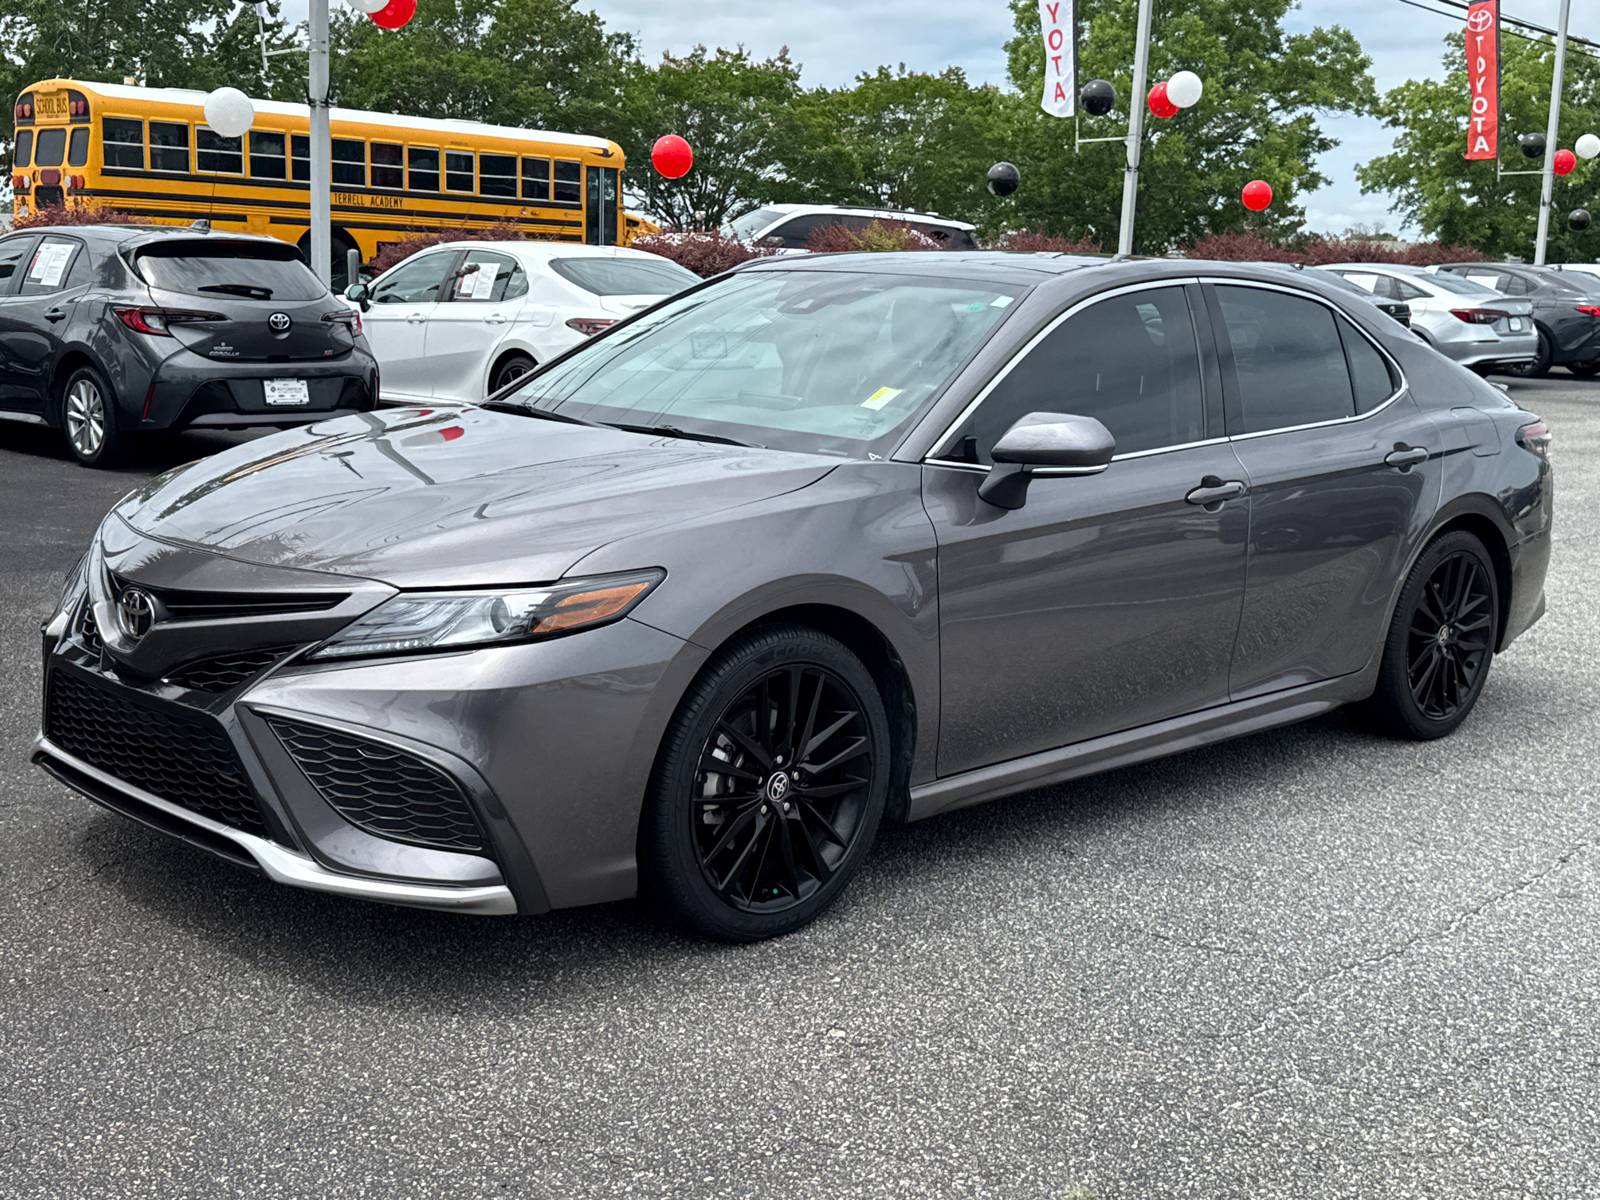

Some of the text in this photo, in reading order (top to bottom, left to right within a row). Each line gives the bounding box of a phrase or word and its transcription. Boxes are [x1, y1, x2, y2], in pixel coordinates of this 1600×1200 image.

[1472, 35, 1489, 153] TOYOTA
[36, 97, 67, 114] SCHOOL BUS
[334, 193, 404, 208] TERRELL ACADEMY
[773, 645, 845, 662] COOPER
